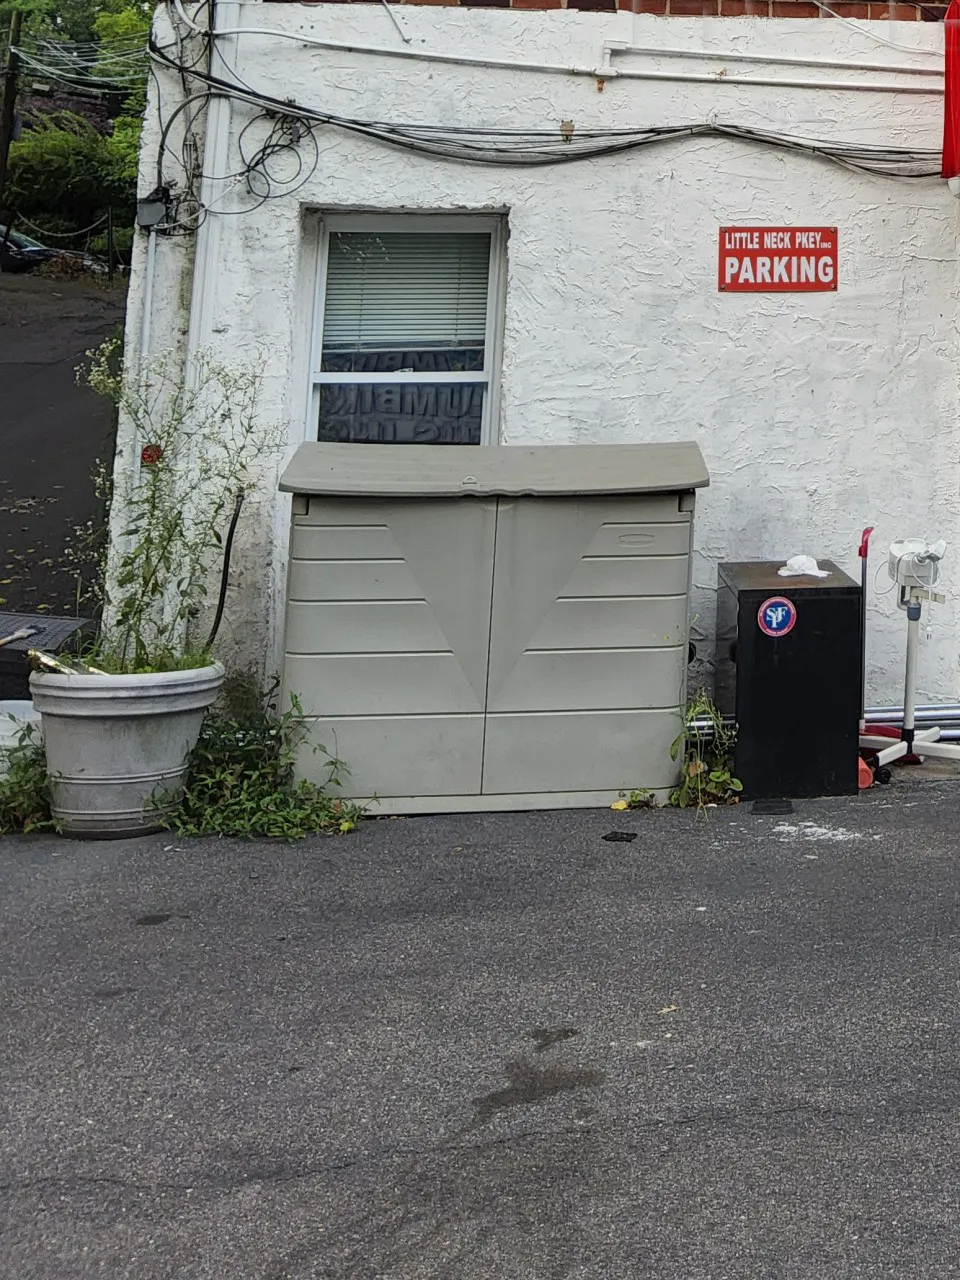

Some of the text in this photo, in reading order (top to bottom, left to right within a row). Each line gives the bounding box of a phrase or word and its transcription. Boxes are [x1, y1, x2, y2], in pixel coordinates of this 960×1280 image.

[725, 232, 760, 249] LITTLE
[763, 232, 791, 249] NECK
[795, 231, 822, 249] PKEY
[724, 256, 834, 284] PARKING
